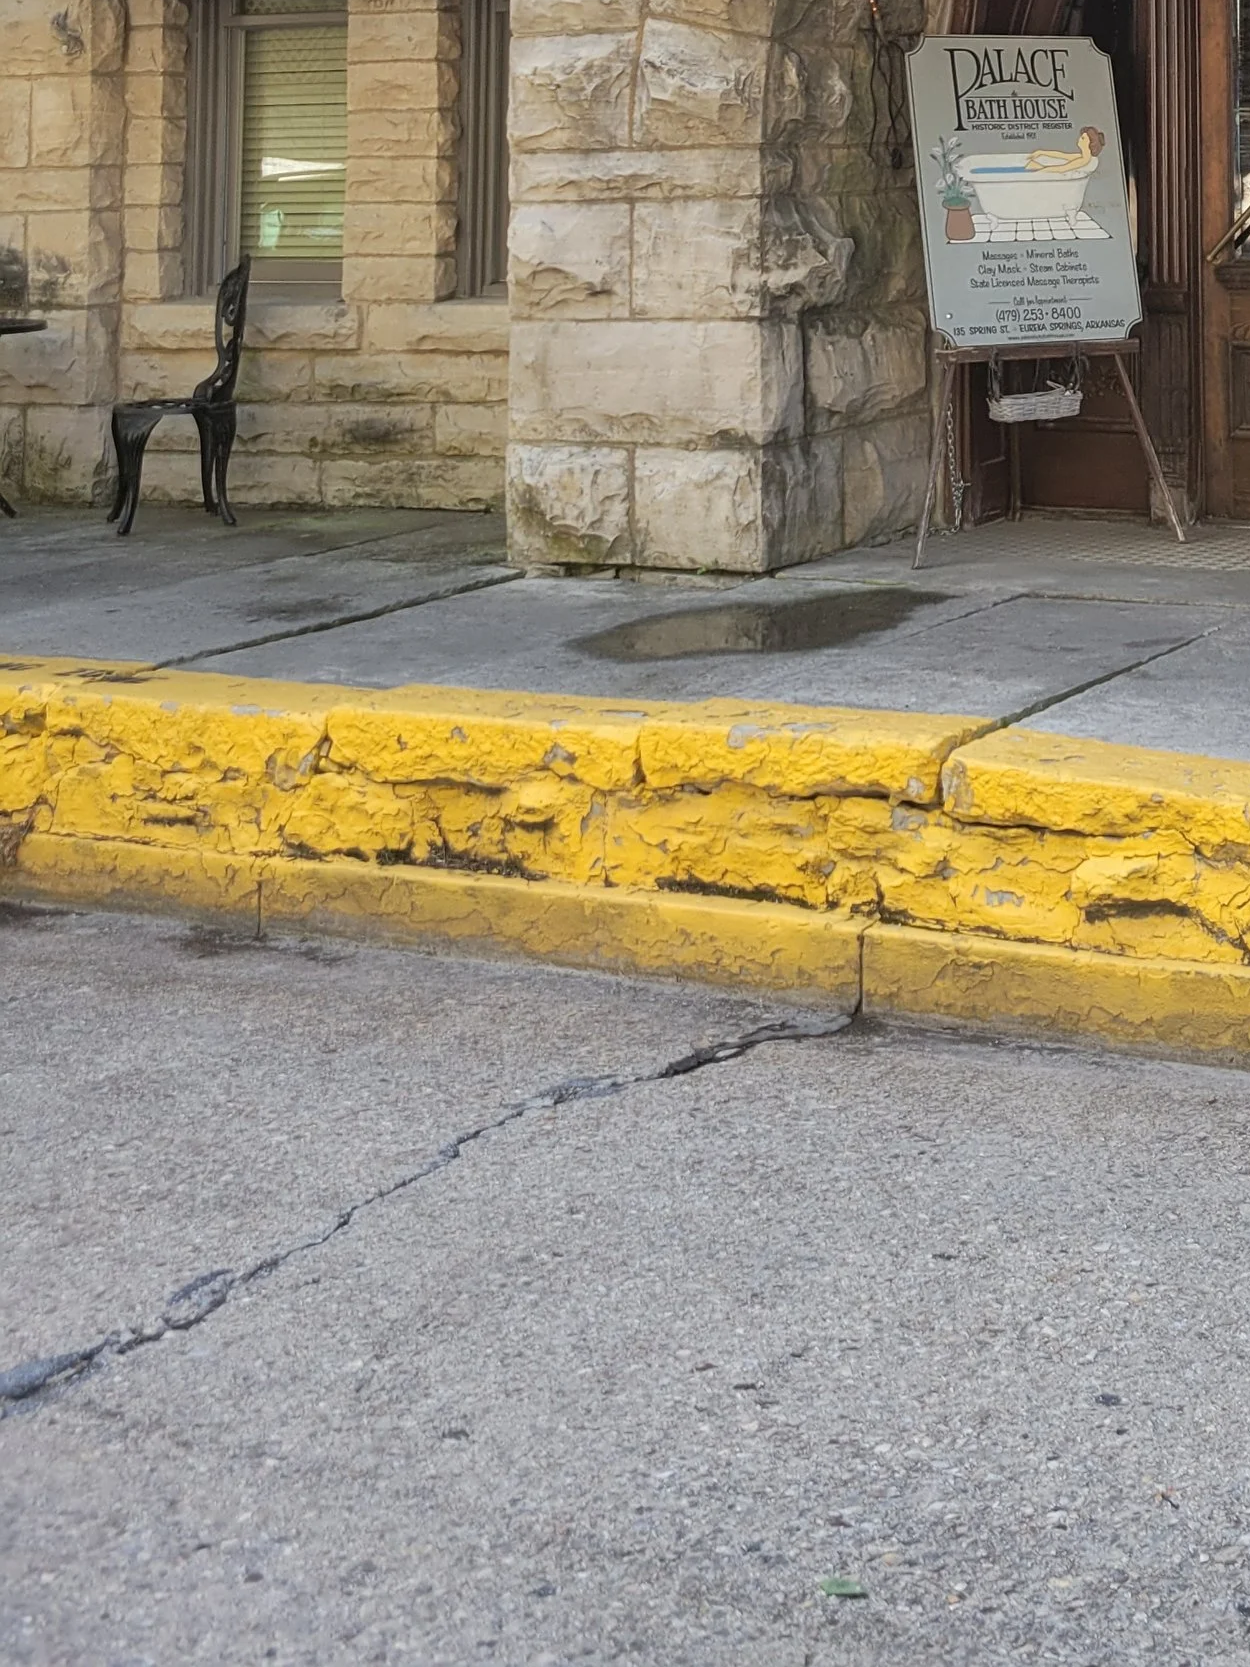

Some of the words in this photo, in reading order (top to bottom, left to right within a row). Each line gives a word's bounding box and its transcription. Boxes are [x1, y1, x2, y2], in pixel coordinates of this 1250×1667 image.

[943, 46, 1074, 131] PALACE
[965, 99, 1009, 120] BATH
[1012, 98, 1068, 119] HOUSE
[972, 123, 1006, 131] HISTORIC
[1008, 122, 1039, 130] DISTRICT
[1042, 122, 1073, 130] REGISTER
[982, 251, 1018, 262] Massages
[1026, 248, 1055, 260] Mineral
[1057, 248, 1079, 259] Baths
[978, 264, 996, 277] Clay
[998, 263, 1022, 274] Mask
[1029, 263, 1054, 273] Steam
[1056, 261, 1088, 272] Cabinets
[970, 278, 989, 289] State
[991, 277, 1026, 288] Licensed
[1027, 277, 1062, 289] Massage
[1063, 274, 1101, 287] Therapists
[995, 308, 1021, 323] (479)
[953, 326, 966, 336] 135
[969, 325, 997, 335] SPRING
[1019, 323, 1047, 333] EUREKA
[1049, 321, 1083, 332] SPRINGS,
[1085, 319, 1125, 330] ARKANSAS
